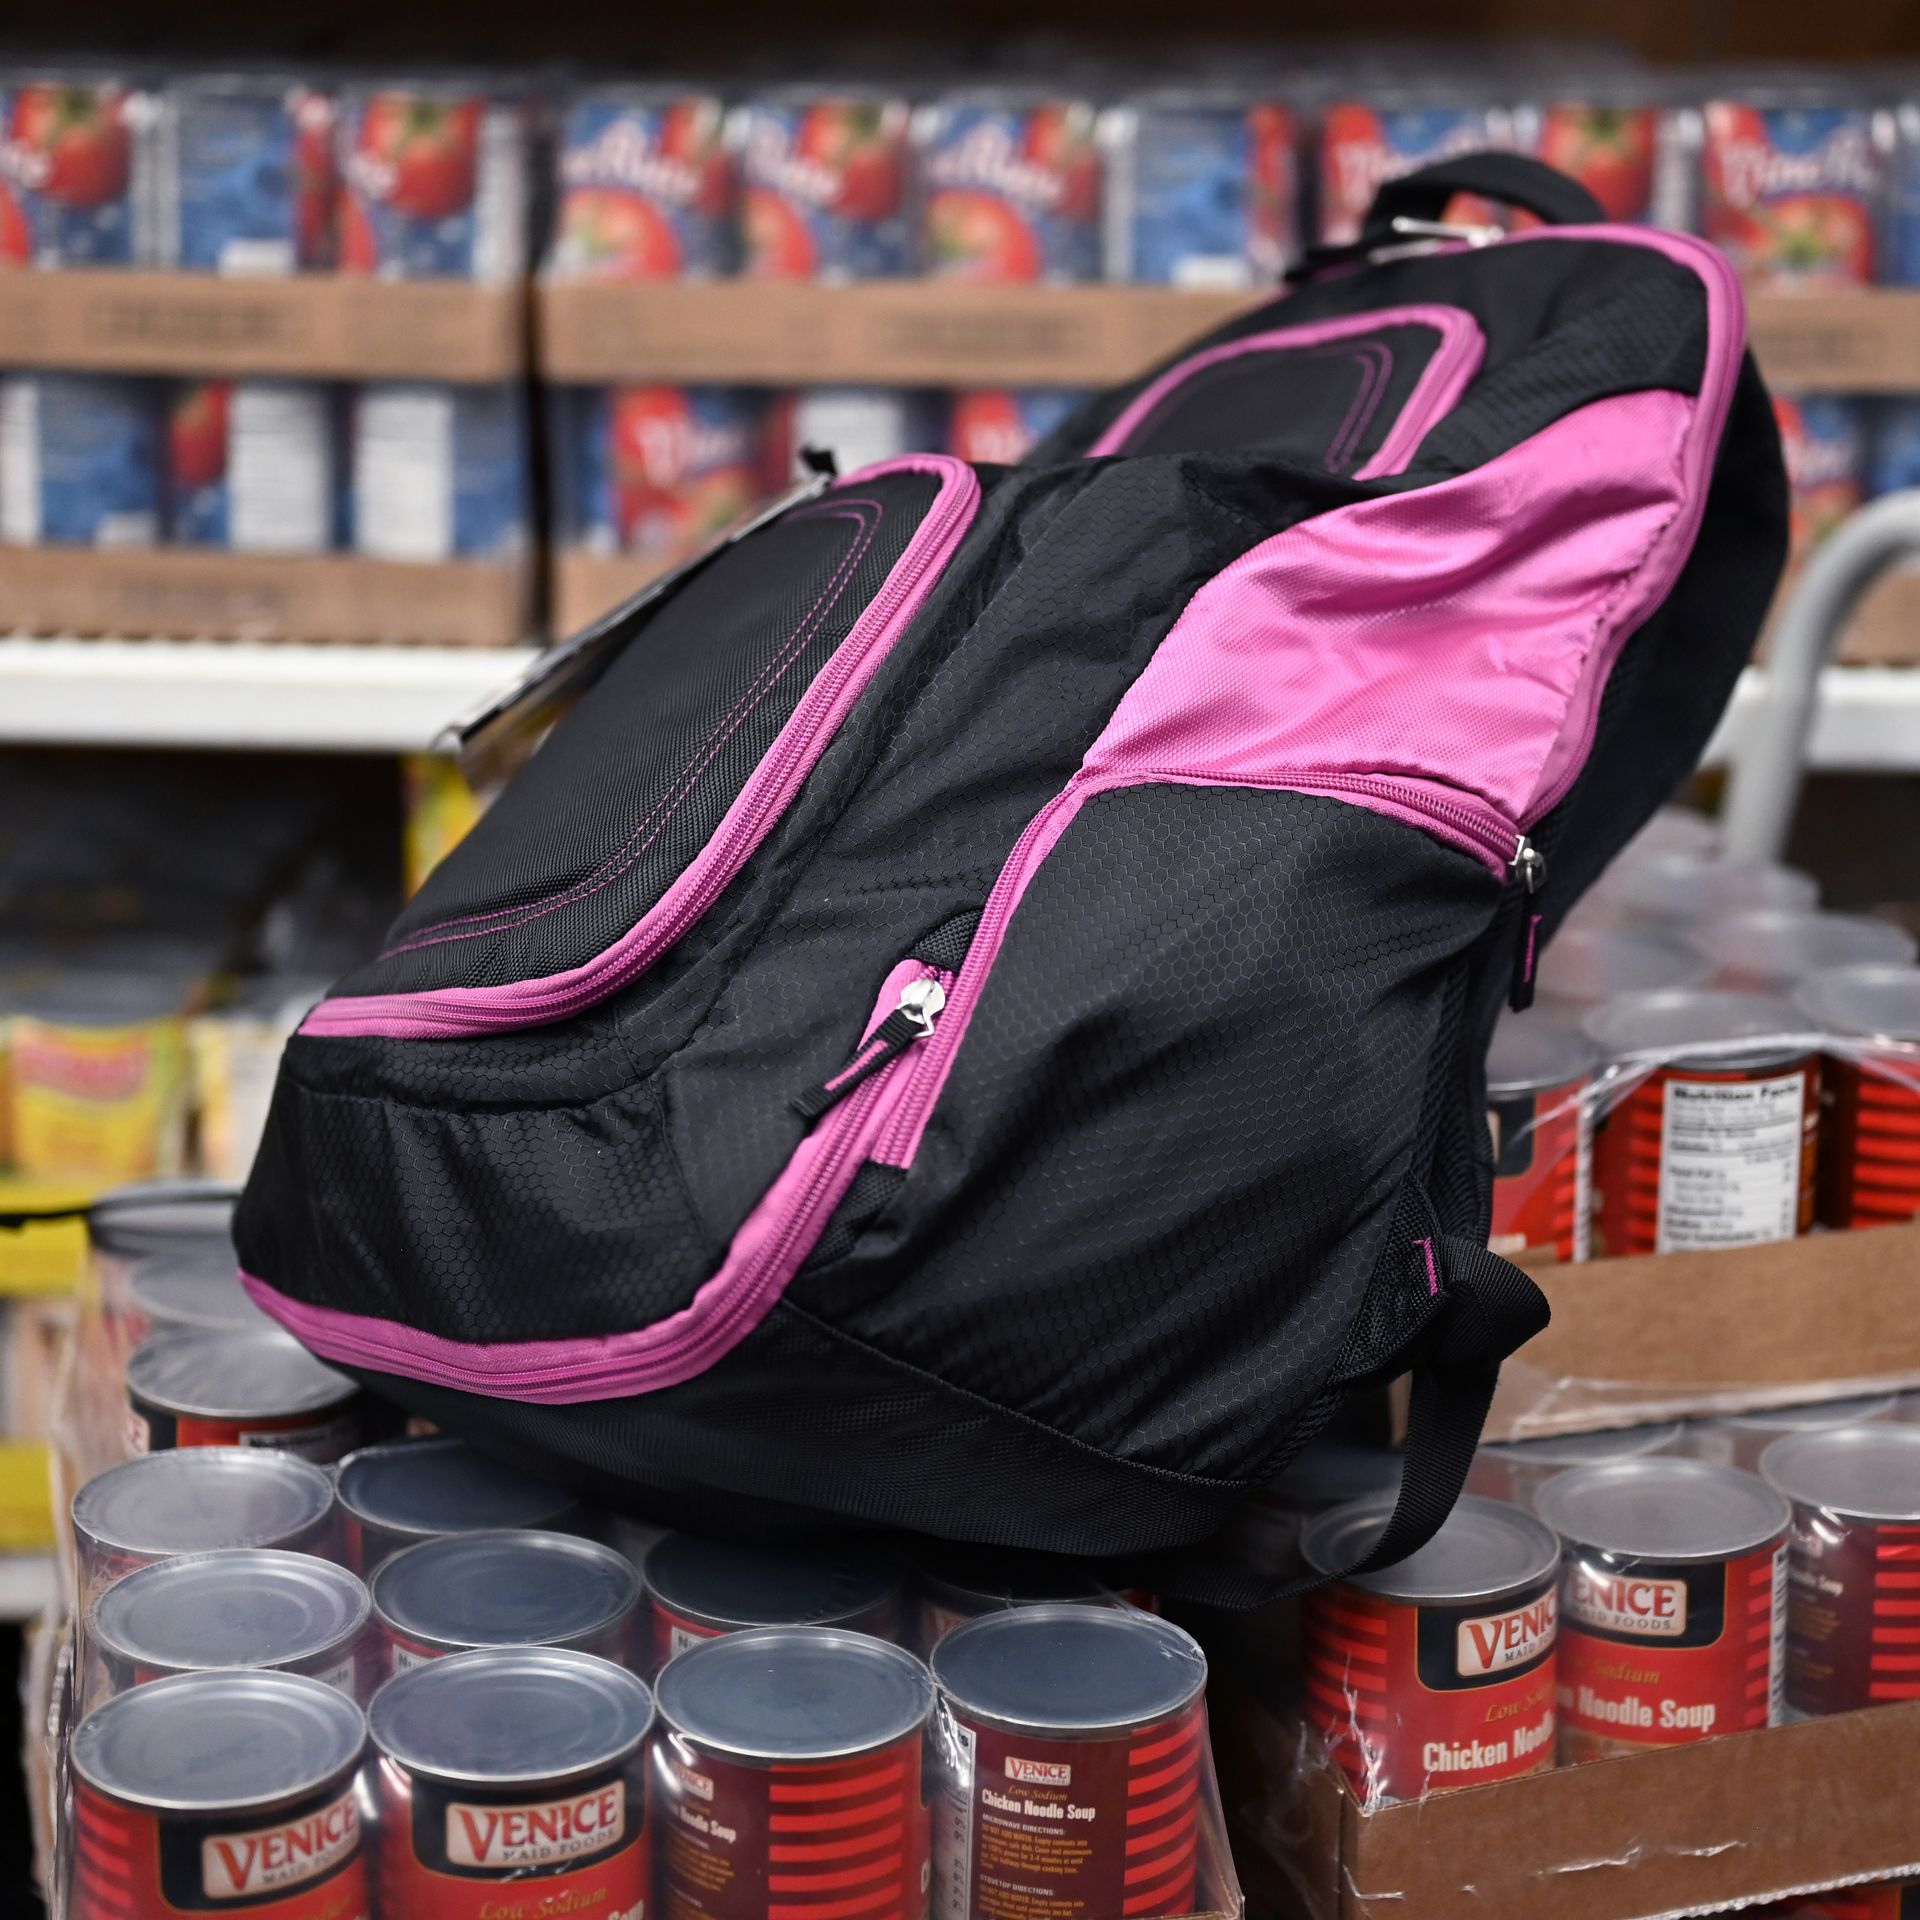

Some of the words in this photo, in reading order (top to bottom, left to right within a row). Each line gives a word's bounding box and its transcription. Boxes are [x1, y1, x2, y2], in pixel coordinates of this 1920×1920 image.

[1571, 1574, 1676, 1617] ENICE
[1614, 1614, 1672, 1631] FOODS
[1578, 1686, 1653, 1727] Noodle
[1659, 1699, 1716, 1734] Soup
[1009, 1758, 1068, 1779] VENICE
[1423, 1739, 1508, 1772] Chicken
[982, 1788, 1021, 1814] Chicken
[1024, 1799, 1064, 1820] Noodle
[1067, 1803, 1096, 1823] Soup
[458, 1789, 617, 1863] VENICE
[214, 1801, 355, 1891] VENICE
